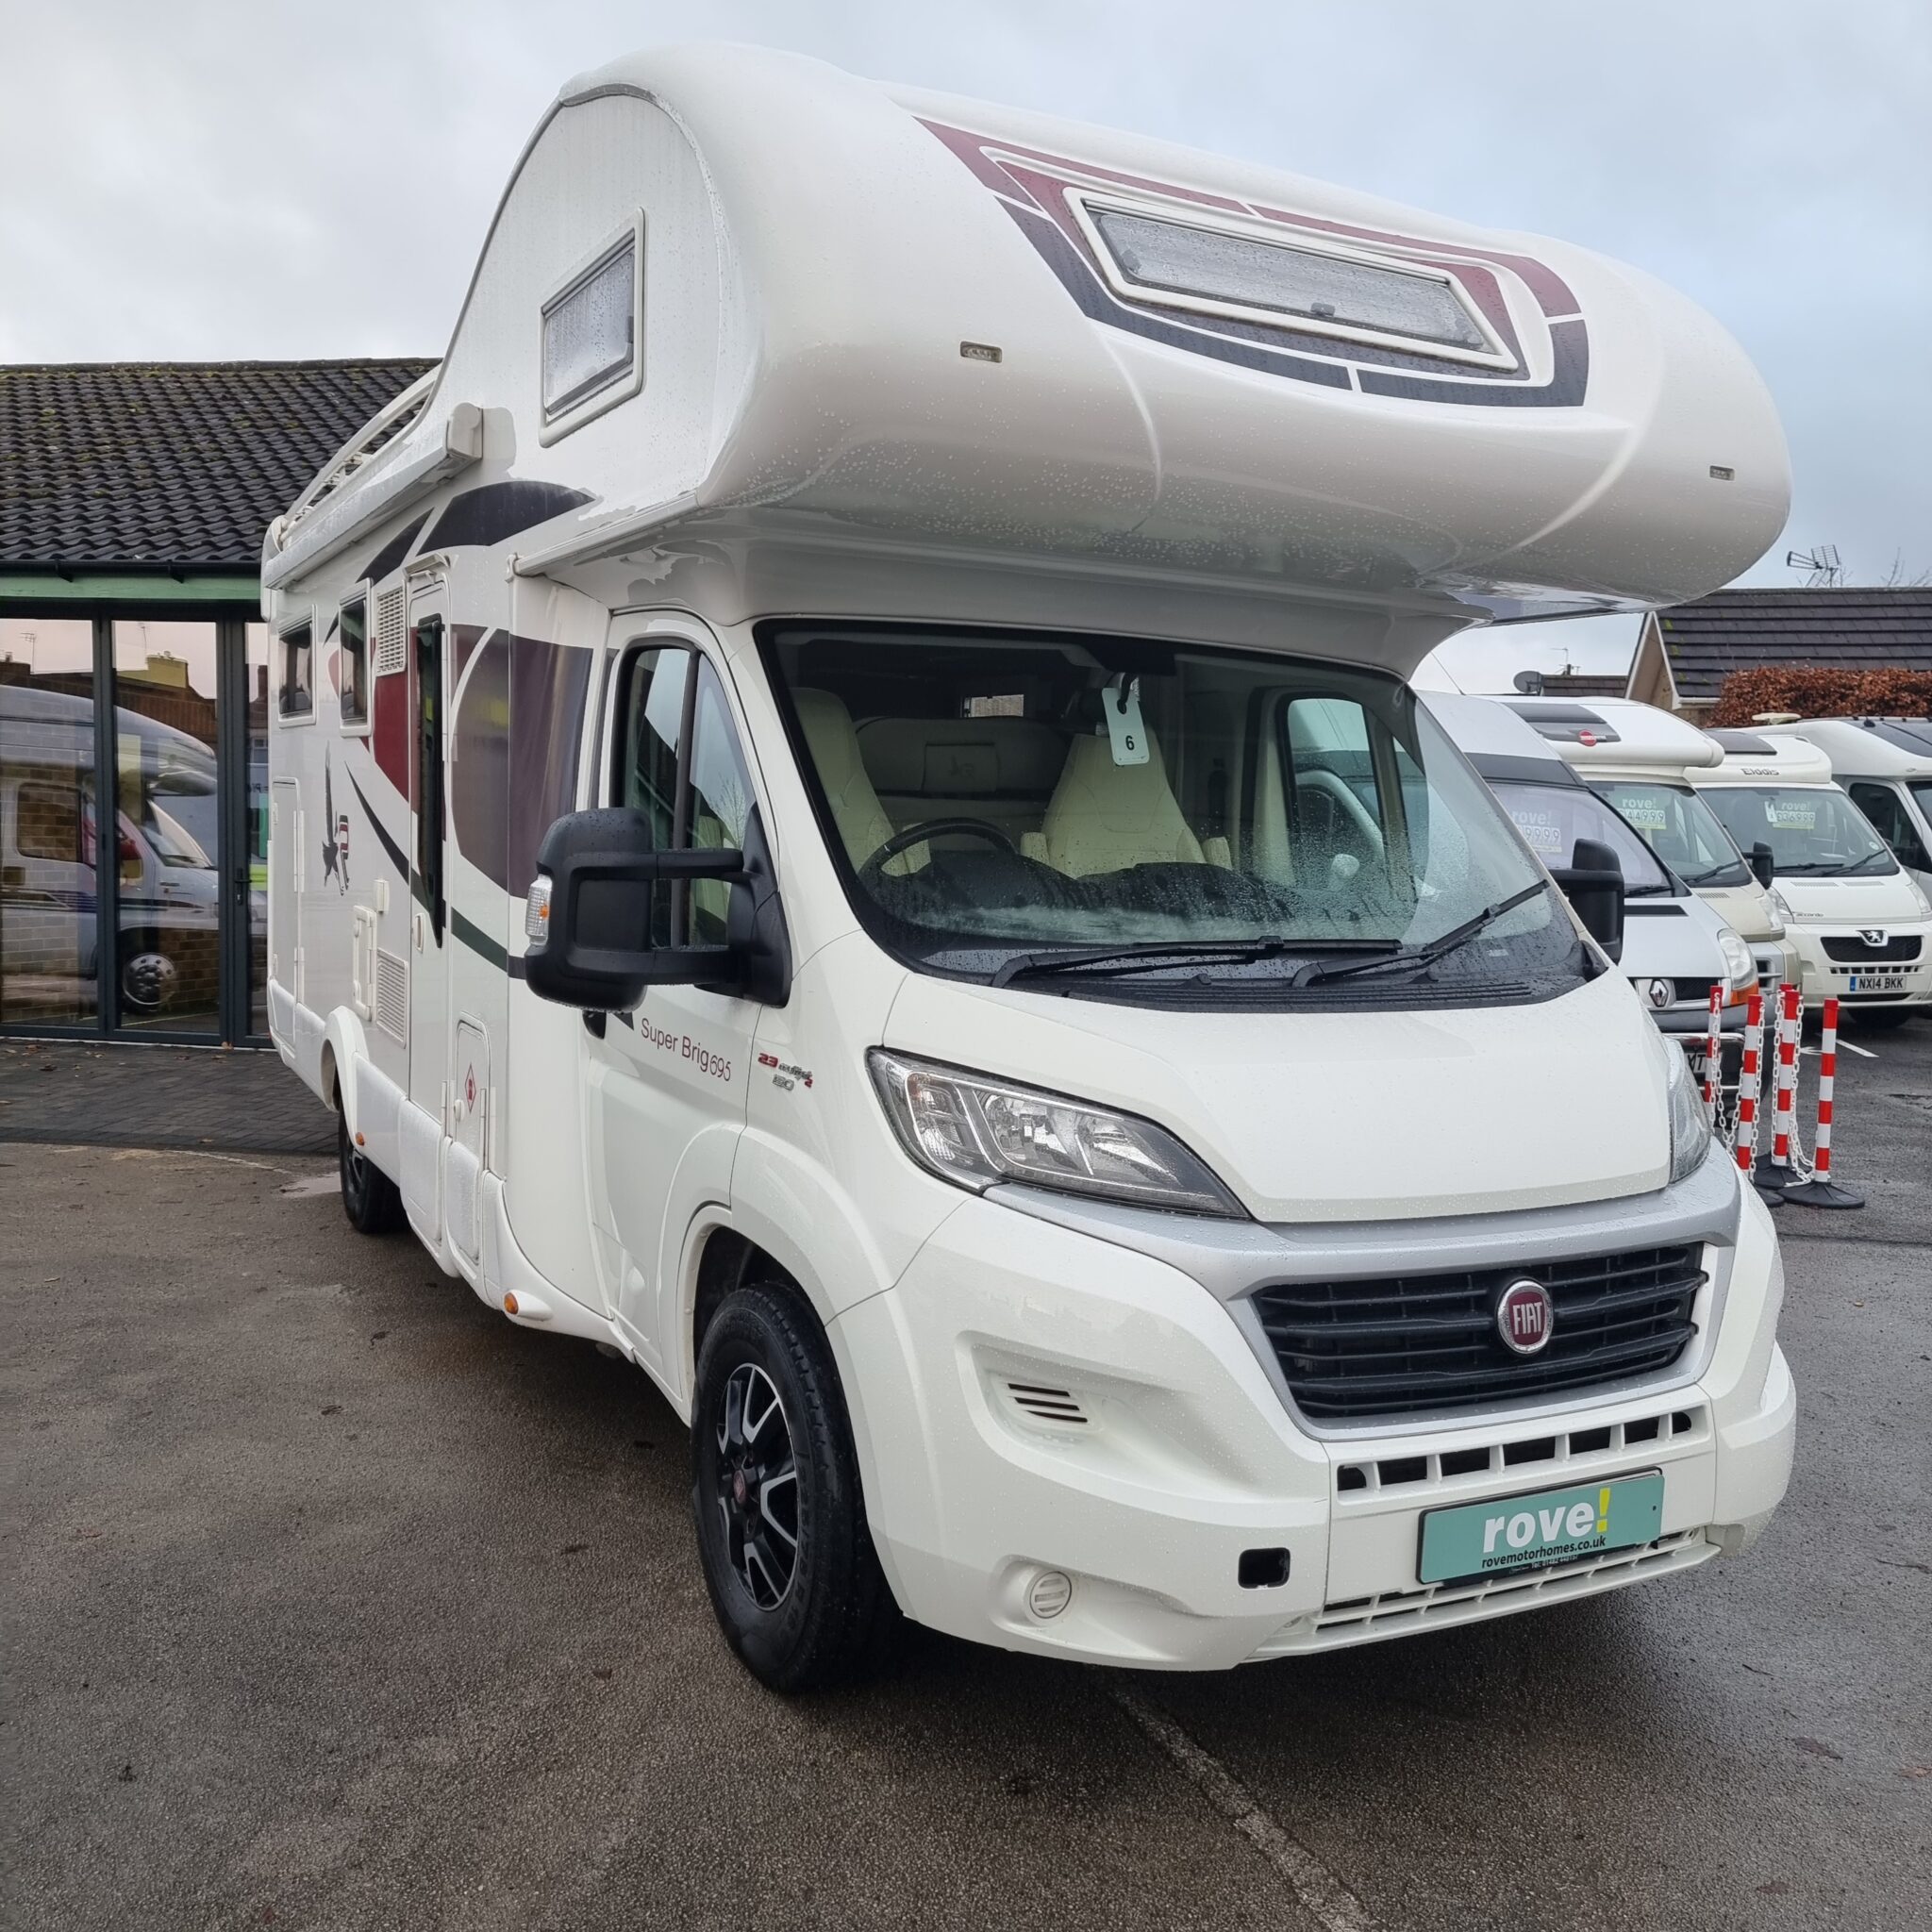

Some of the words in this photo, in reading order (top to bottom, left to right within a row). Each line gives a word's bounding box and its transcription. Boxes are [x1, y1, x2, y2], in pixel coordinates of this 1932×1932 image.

[1124, 735, 1136, 752] 6
[1622, 797, 1657, 809] rove!
[1511, 809, 1553, 825] rove!
[1858, 977, 1882, 990] NX14
[641, 1018, 678, 1052] Super
[1512, 1302, 1543, 1335] FIAT
[1483, 1487, 1610, 1554] rove!
[1481, 1535, 1607, 1568] rovemotorhomes.co.uk
